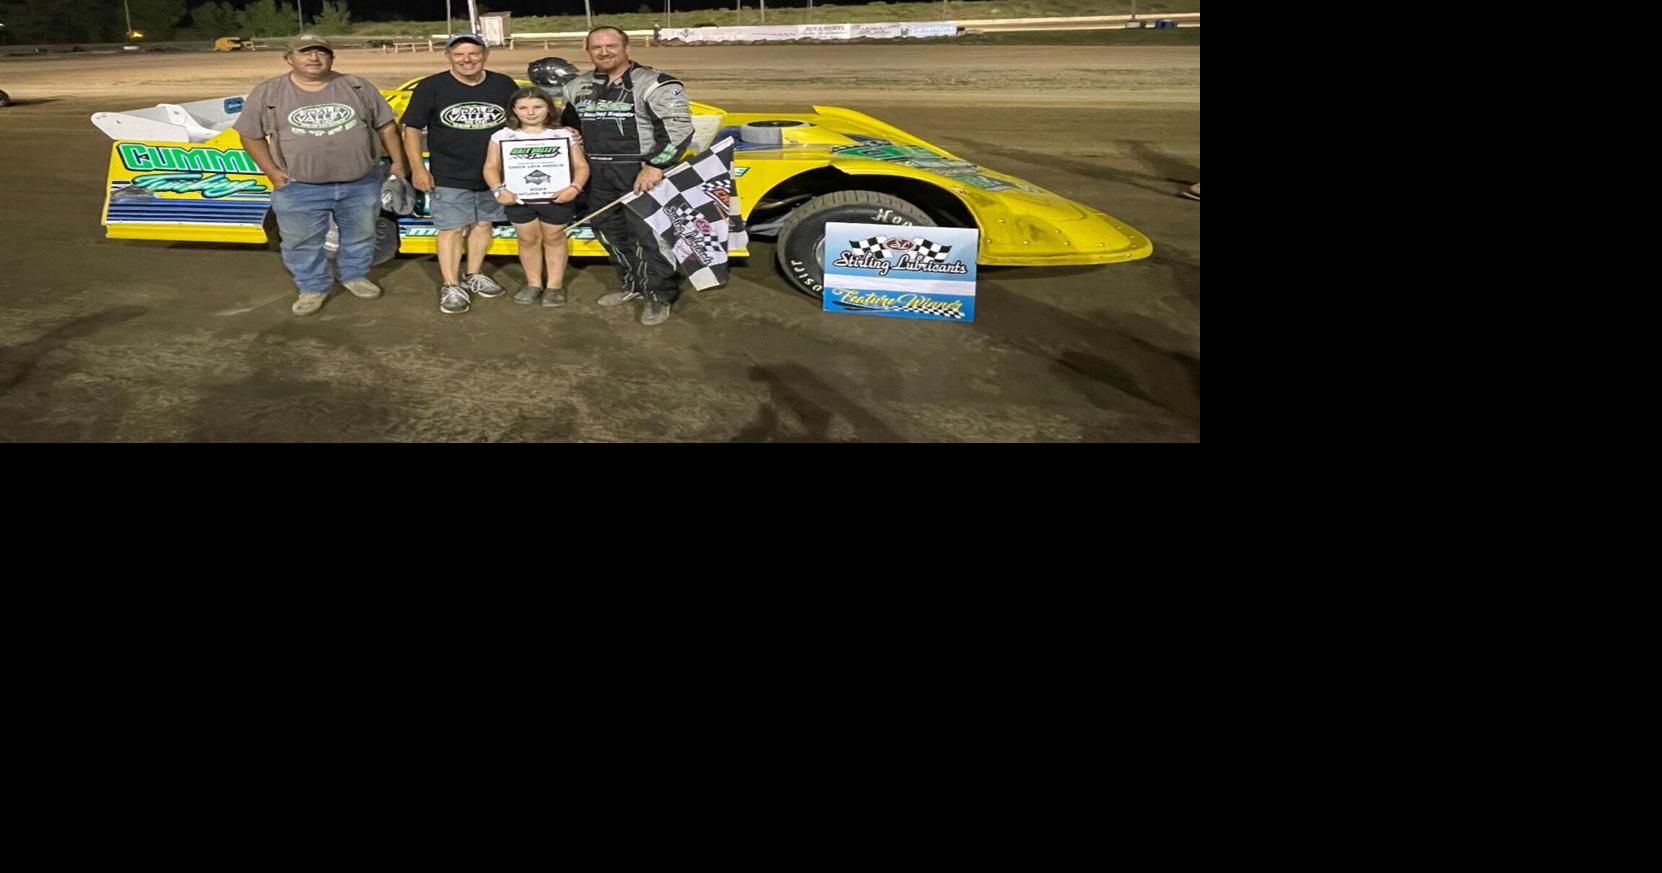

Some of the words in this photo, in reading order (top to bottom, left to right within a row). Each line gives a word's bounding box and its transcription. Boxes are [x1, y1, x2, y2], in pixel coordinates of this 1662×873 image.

[448, 112, 501, 122] VALLEY
[832, 250, 891, 276] Stirling
[891, 253, 968, 274] Lubricants
[832, 288, 897, 306] Feature
[897, 292, 963, 311] Winner
